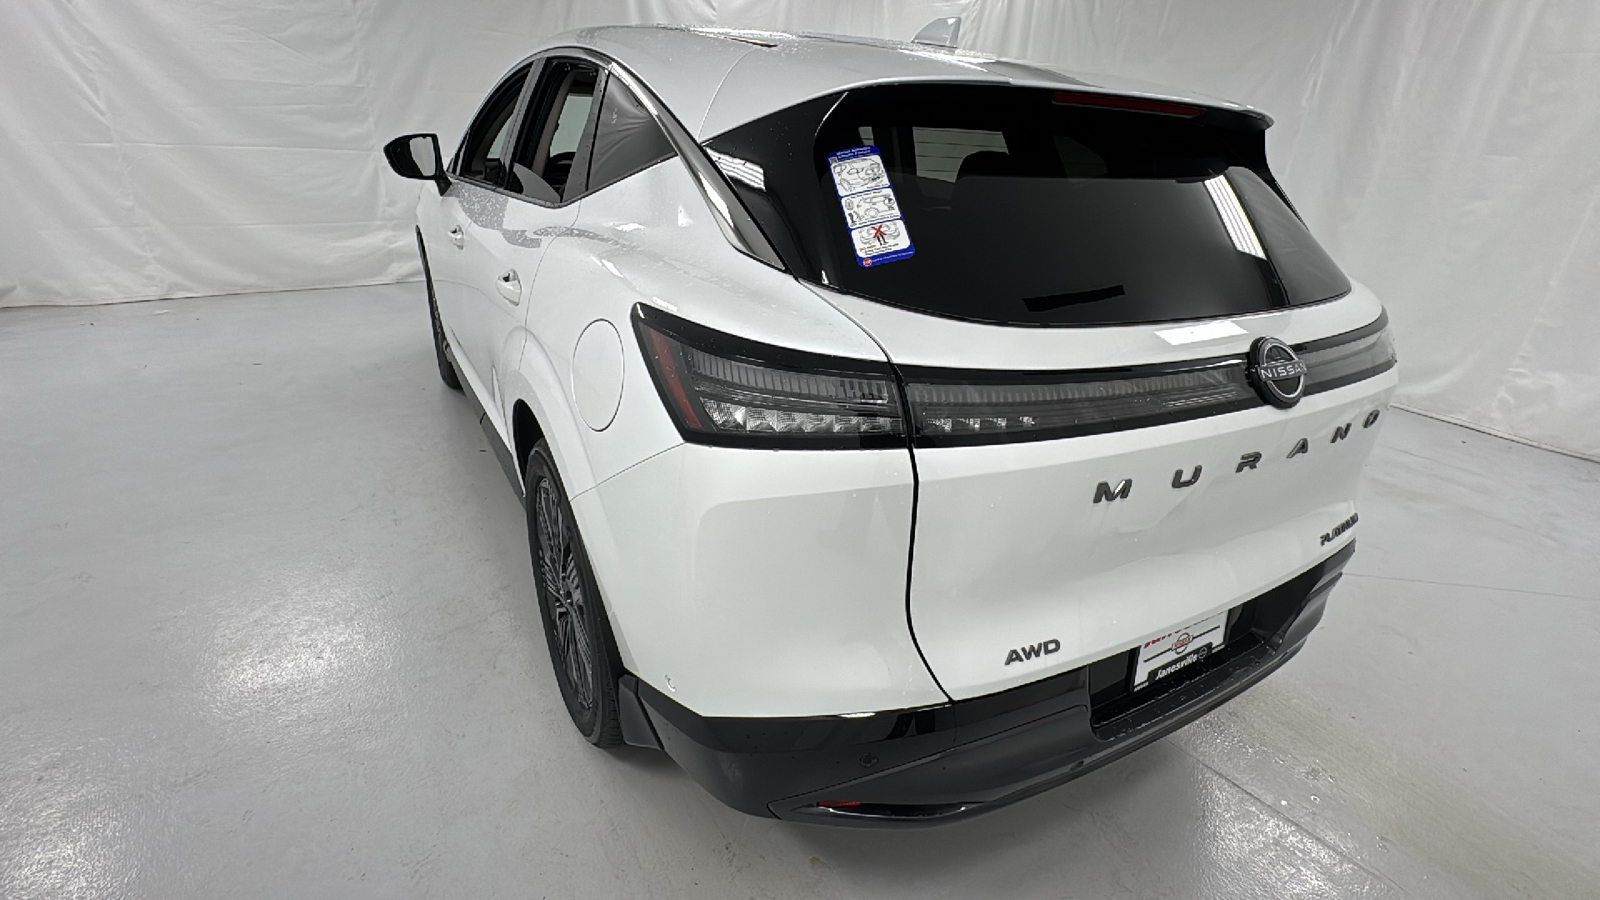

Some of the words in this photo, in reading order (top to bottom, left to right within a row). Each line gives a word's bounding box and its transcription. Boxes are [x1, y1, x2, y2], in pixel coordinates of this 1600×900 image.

[1261, 361, 1307, 379] NISSAN
[1092, 409, 1381, 503] MURANO
[1004, 638, 1060, 666] AWD
[1155, 653, 1198, 680] Janesville
